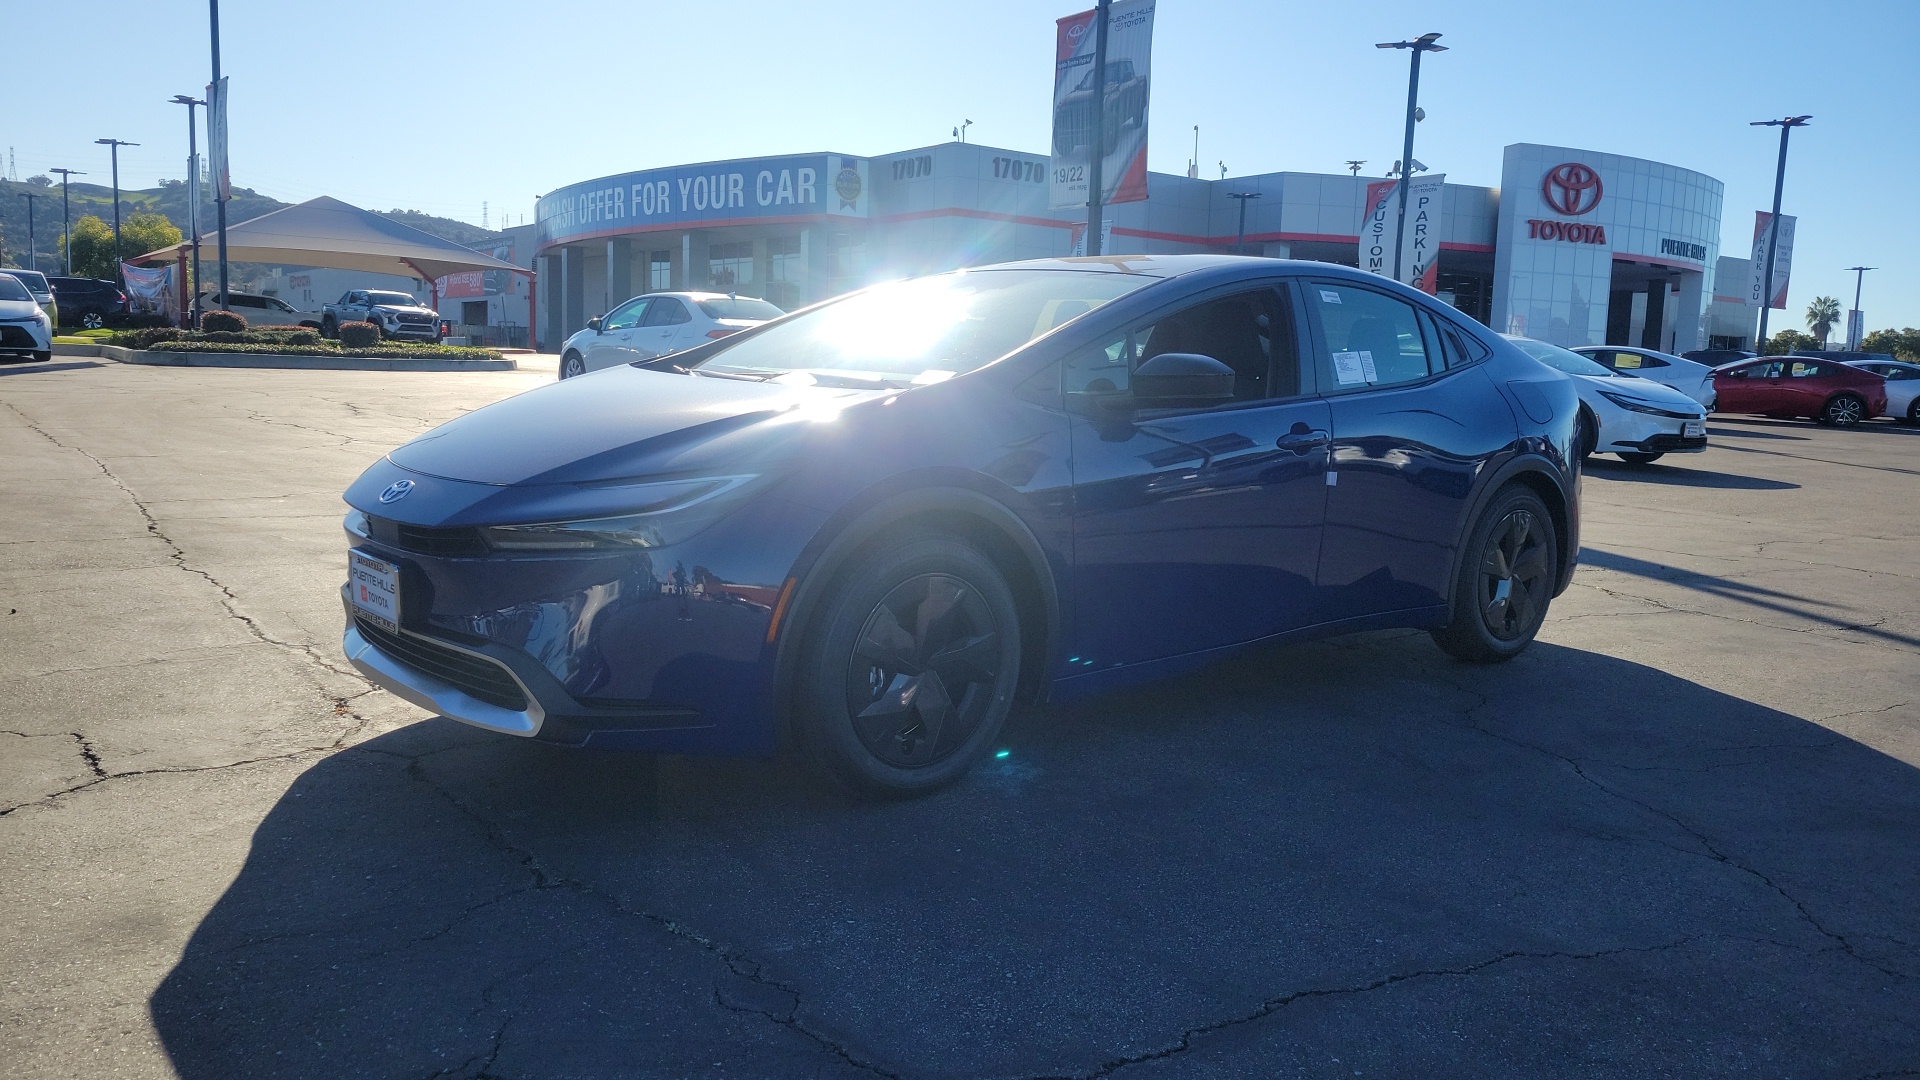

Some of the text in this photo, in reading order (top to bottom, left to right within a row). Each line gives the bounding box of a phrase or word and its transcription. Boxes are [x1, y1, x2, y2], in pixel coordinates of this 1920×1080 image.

[1109, 5, 1154, 25] PUENTE HILLS
[1124, 16, 1146, 28] TOYOTA
[892, 155, 931, 181] 17070
[992, 156, 1045, 184] 17070
[1053, 166, 1083, 184] 19/22
[552, 196, 575, 231] CASH
[579, 187, 625, 224] OFFER
[631, 181, 670, 217] FOR
[678, 173, 744, 212] YOUR
[756, 167, 816, 207] CAR
[1412, 197, 1429, 288] PARKING
[1527, 219, 1607, 245] TOYOTA
[1661, 238, 1691, 258] PUENTE
[1752, 229, 1766, 300] THANK YOU
[358, 557, 384, 573] TOYOTA
[352, 567, 395, 594] PUENTE HILLS
[368, 591, 389, 610] TOYOTA
[352, 606, 395, 632] PUENTE HILLS
